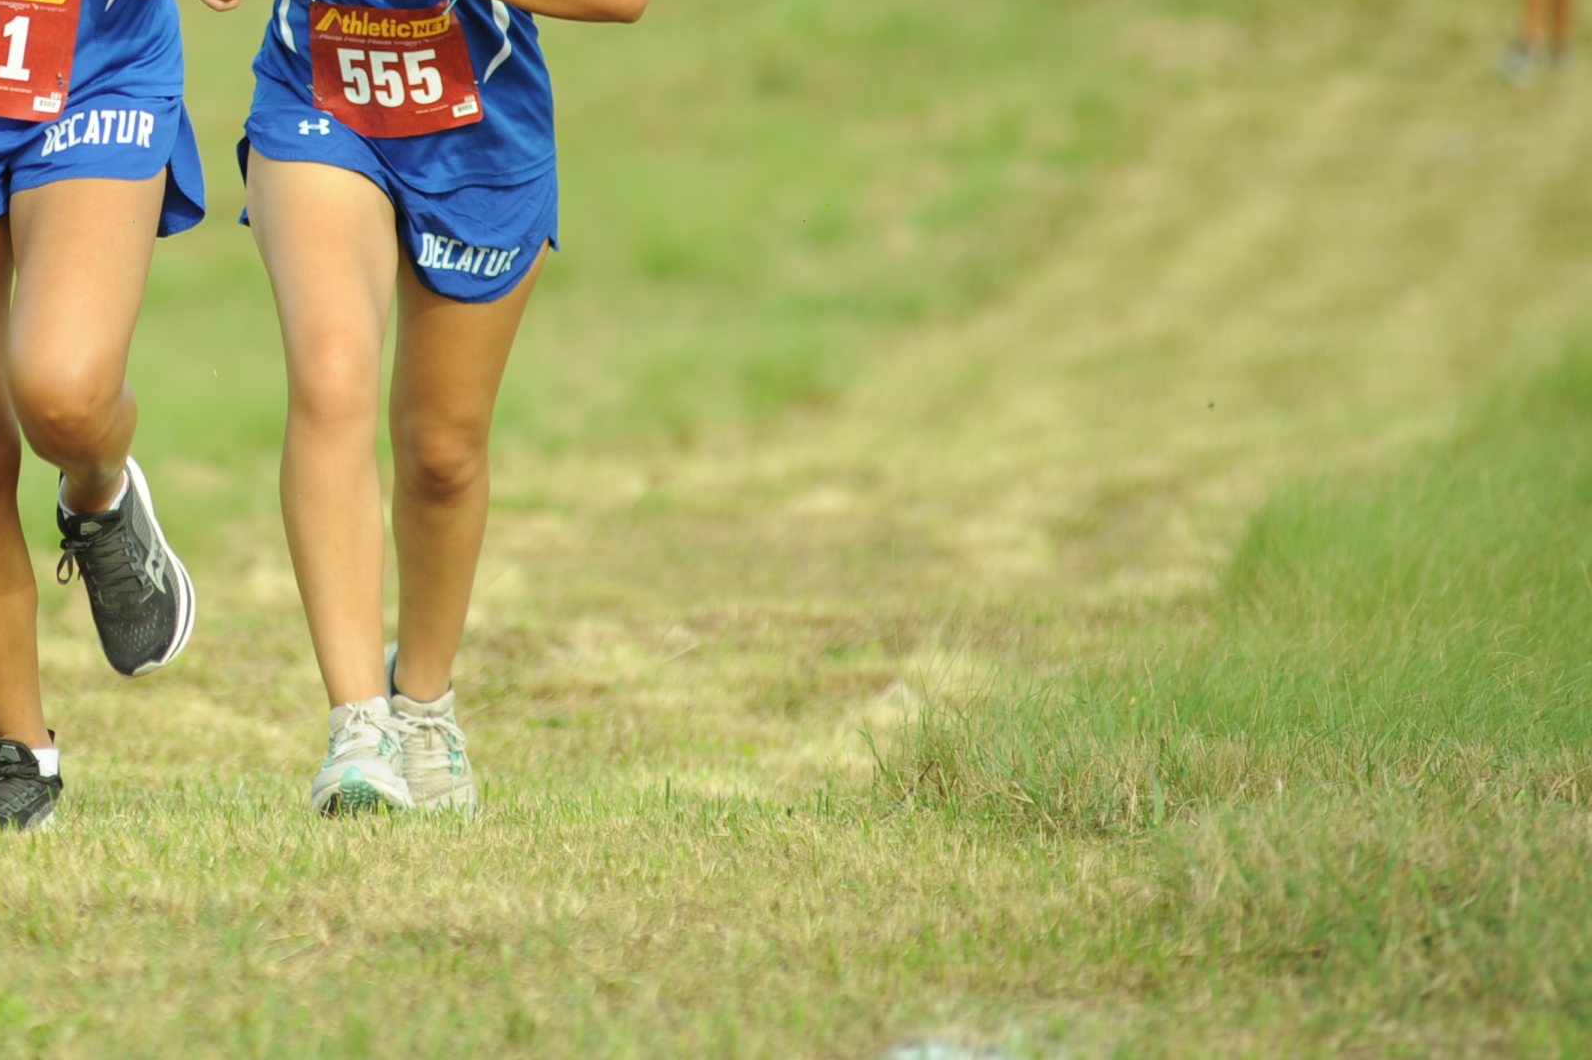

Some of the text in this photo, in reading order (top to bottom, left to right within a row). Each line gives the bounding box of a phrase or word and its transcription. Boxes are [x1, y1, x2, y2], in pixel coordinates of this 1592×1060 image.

[315, 7, 412, 38] Athletic
[337, 47, 444, 108] 555
[41, 109, 155, 158] DECATUR
